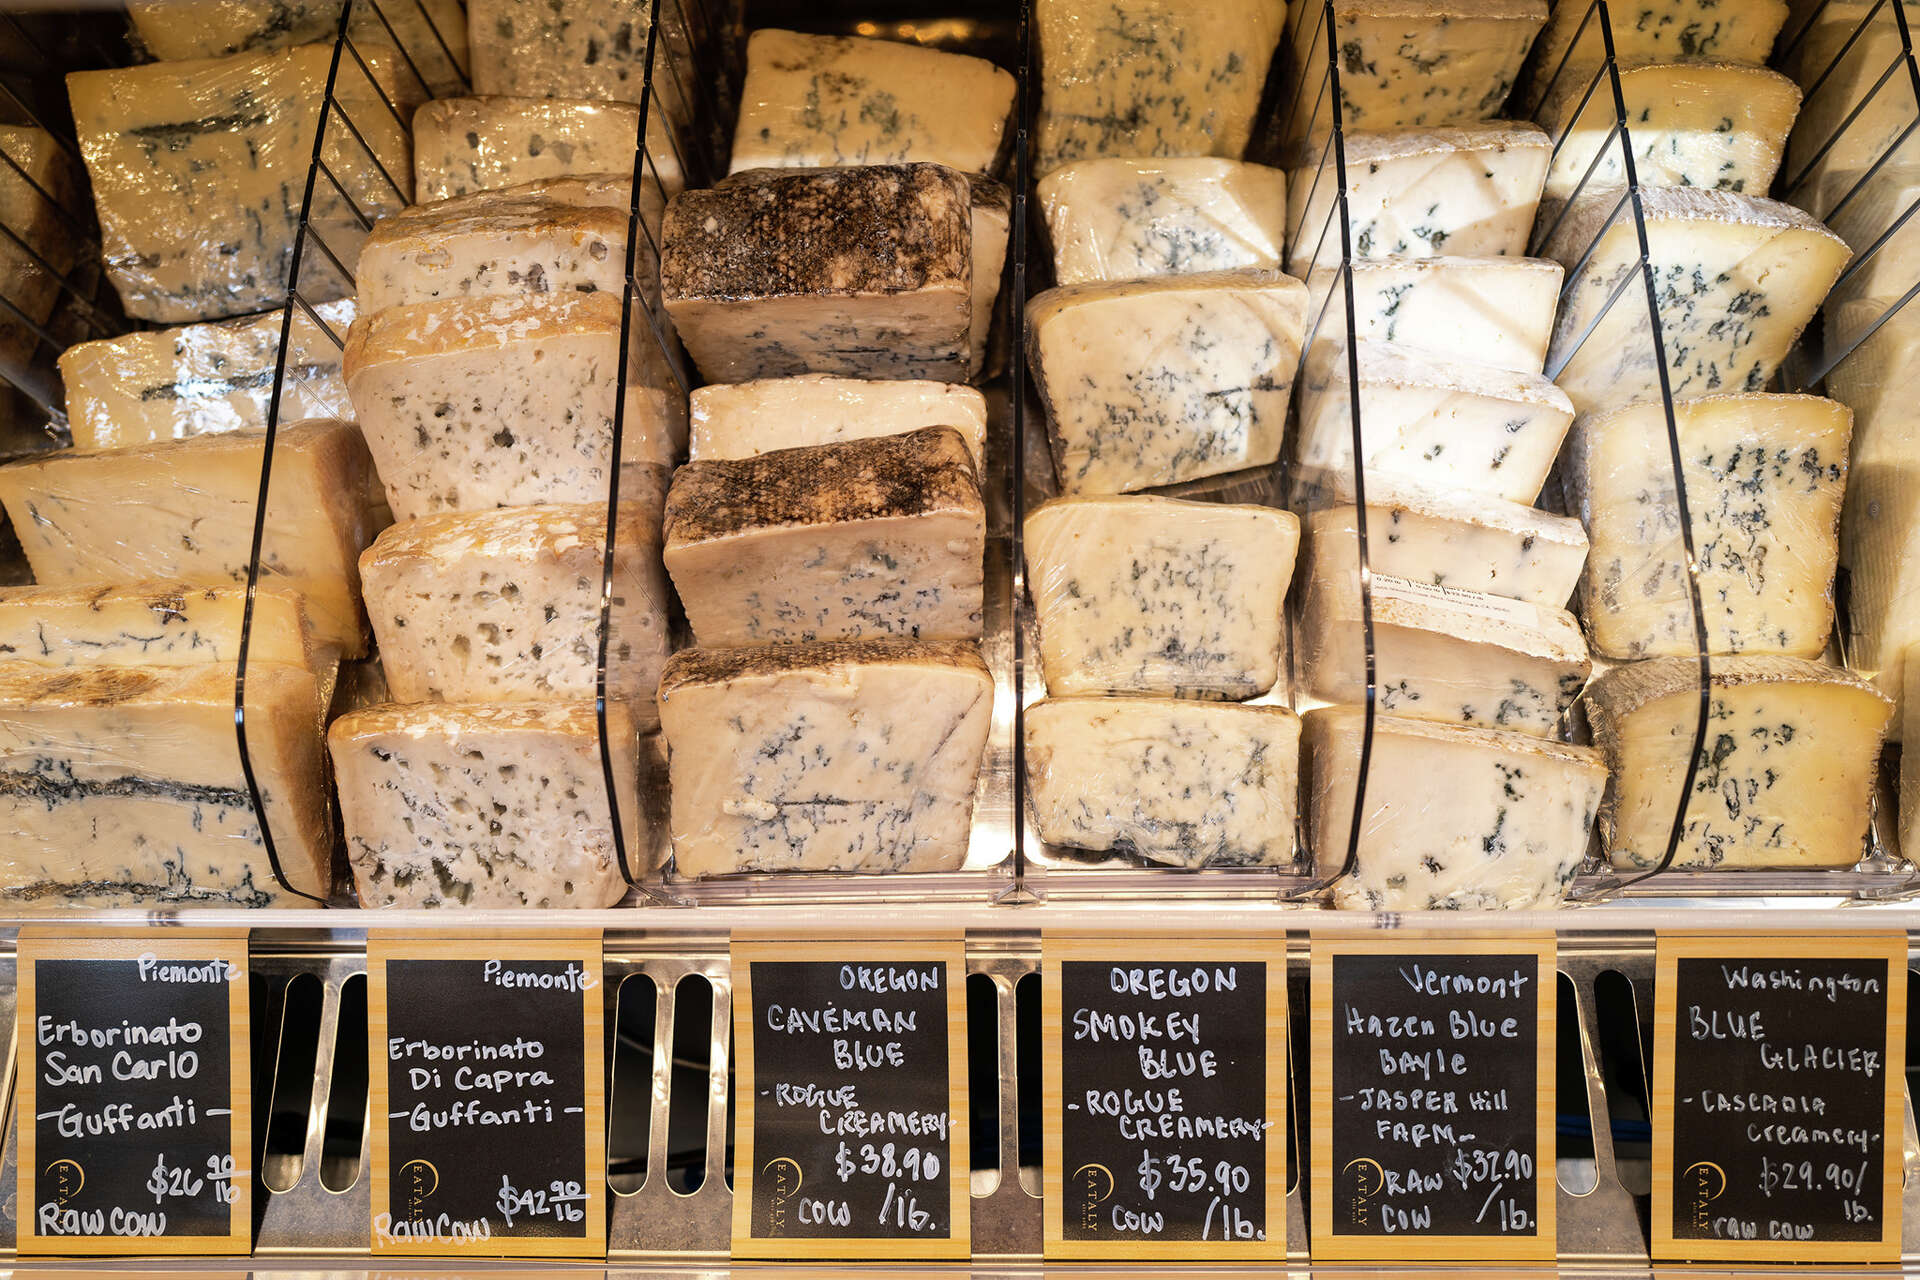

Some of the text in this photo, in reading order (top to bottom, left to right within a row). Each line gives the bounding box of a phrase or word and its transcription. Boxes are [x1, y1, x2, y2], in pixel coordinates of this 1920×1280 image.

[138, 952, 242, 982] Piemonte
[484, 960, 598, 992] Piemonte
[840, 965, 938, 992] OREGON
[1111, 967, 1236, 1000] OREGON
[1400, 964, 1528, 998] Vermont
[1721, 965, 1879, 1002] Washington
[38, 1016, 202, 1048] Erborinato
[767, 1004, 916, 1033] CAVEMAN
[1073, 1008, 1200, 1044] SMOKEY
[1450, 1010, 1518, 1039] Blue
[1689, 1005, 1765, 1040] BLUE
[389, 1038, 544, 1060] Erborinato
[833, 1039, 904, 1070] BLUE
[1139, 1045, 1217, 1079] BLUE
[1760, 1044, 1880, 1078] GLACIER
[45, 1051, 101, 1086] San
[409, 1067, 553, 1092] Di Capra
[1469, 1090, 1508, 1111] Hill
[836, 1142, 940, 1182] $38.90
[1138, 1149, 1250, 1199] $35.90
[1453, 1149, 1532, 1190] $32.90
[776, 1164, 786, 1228] EATALY
[1087, 1170, 1097, 1231] EATALY
[1358, 1164, 1367, 1226] EATALY
[1699, 1167, 1709, 1230] EATALY
[39, 1203, 104, 1236] Raw
